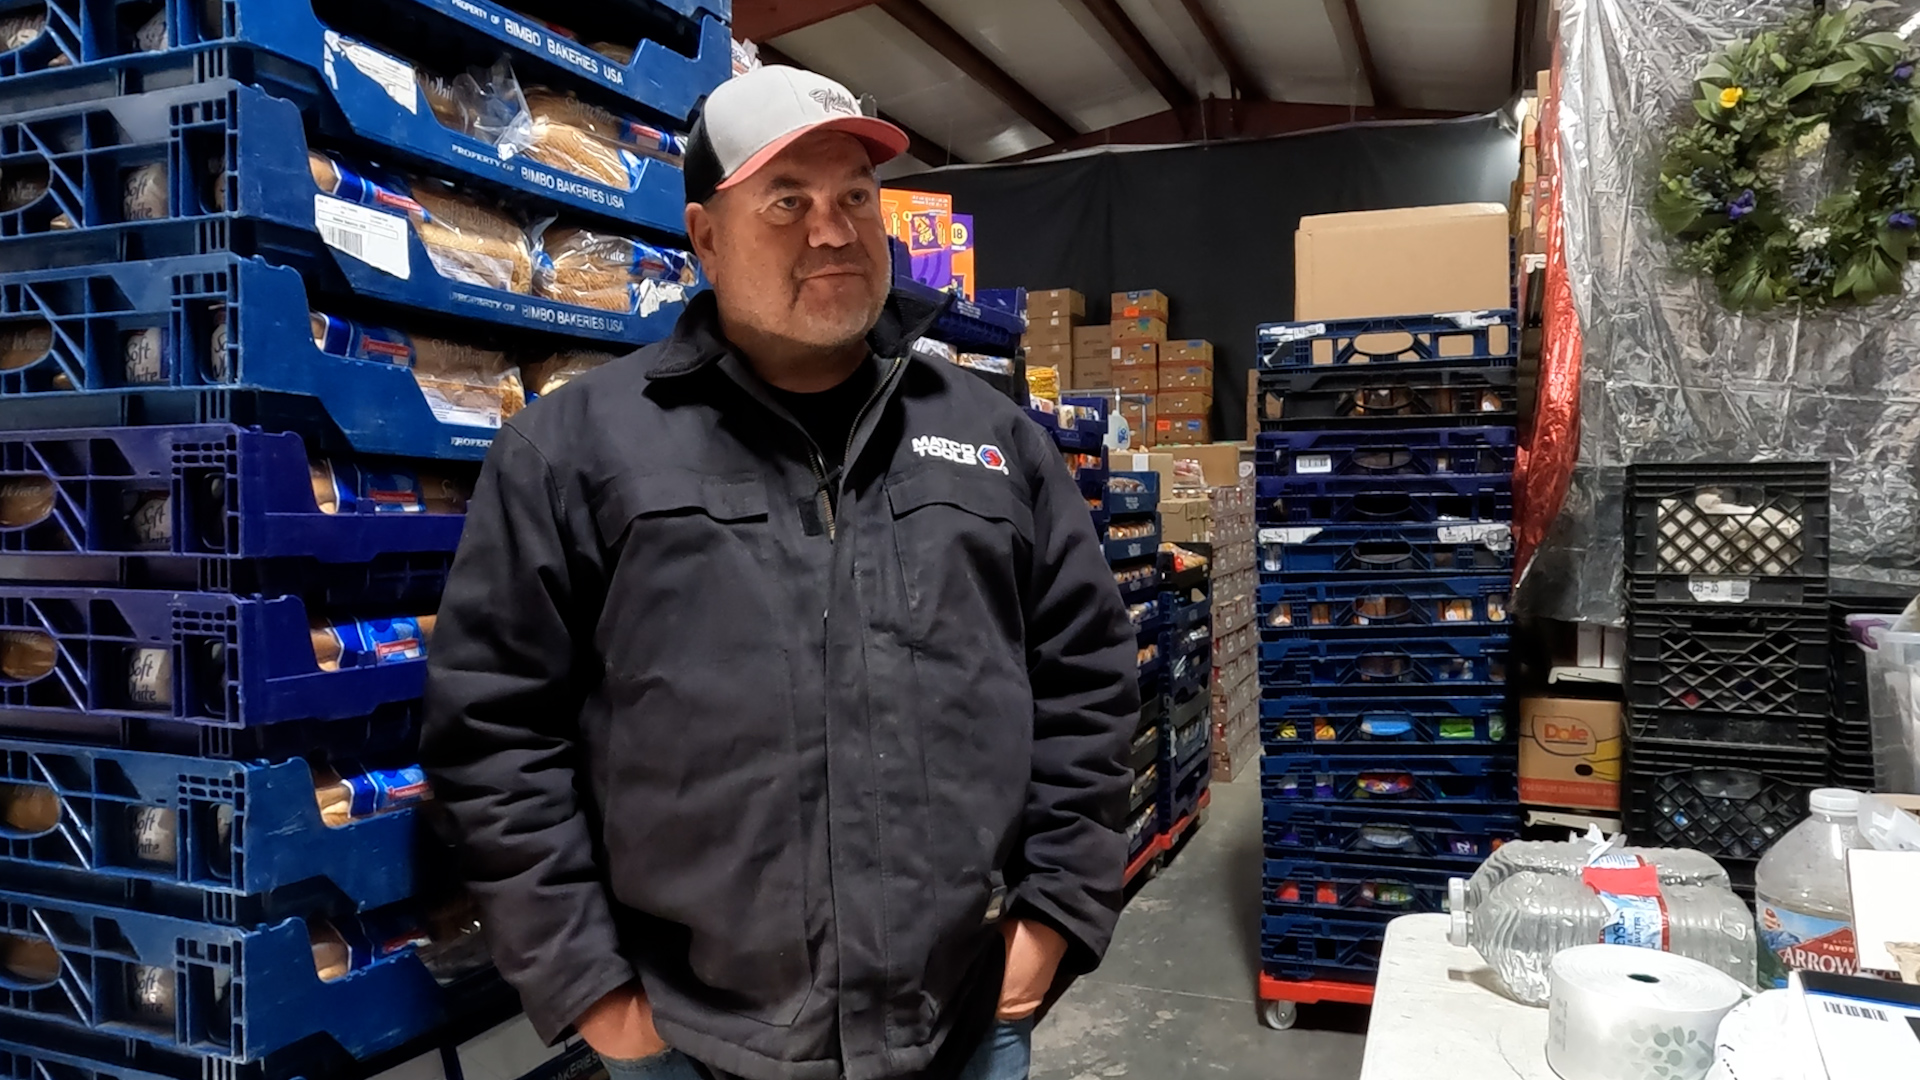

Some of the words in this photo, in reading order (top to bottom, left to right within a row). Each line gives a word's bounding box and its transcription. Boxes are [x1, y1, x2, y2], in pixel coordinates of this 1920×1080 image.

[452, 0, 487, 19] PROPERTY
[491, 15, 500, 24] OF
[504, 18, 541, 47] BIMBO
[547, 38, 599, 74] BAKERIES
[603, 64, 625, 86] USA
[122, 178, 147, 200] Soft
[452, 143, 500, 168] PROPERTY
[503, 162, 515, 172] OF
[521, 166, 555, 190] BIMBO
[556, 179, 605, 205] BAKERIES
[606, 191, 626, 209] USA
[953, 228, 964, 240] 18
[503, 303, 515, 312] OF
[521, 304, 556, 324] BIMBO
[557, 308, 605, 331] BAKERIES
[606, 316, 625, 332] USA
[125, 337, 152, 363] Soft
[911, 435, 976, 455] MATCO
[913, 446, 978, 465] TOOLS
[140, 503, 165, 528] Soft
[128, 654, 153, 680] Soft
[1544, 723, 1589, 741] Dole
[132, 808, 156, 834] Soft
[1783, 946, 1857, 976] ARROW
[135, 967, 156, 993] Soft
[550, 1051, 599, 1080] AKERIES
